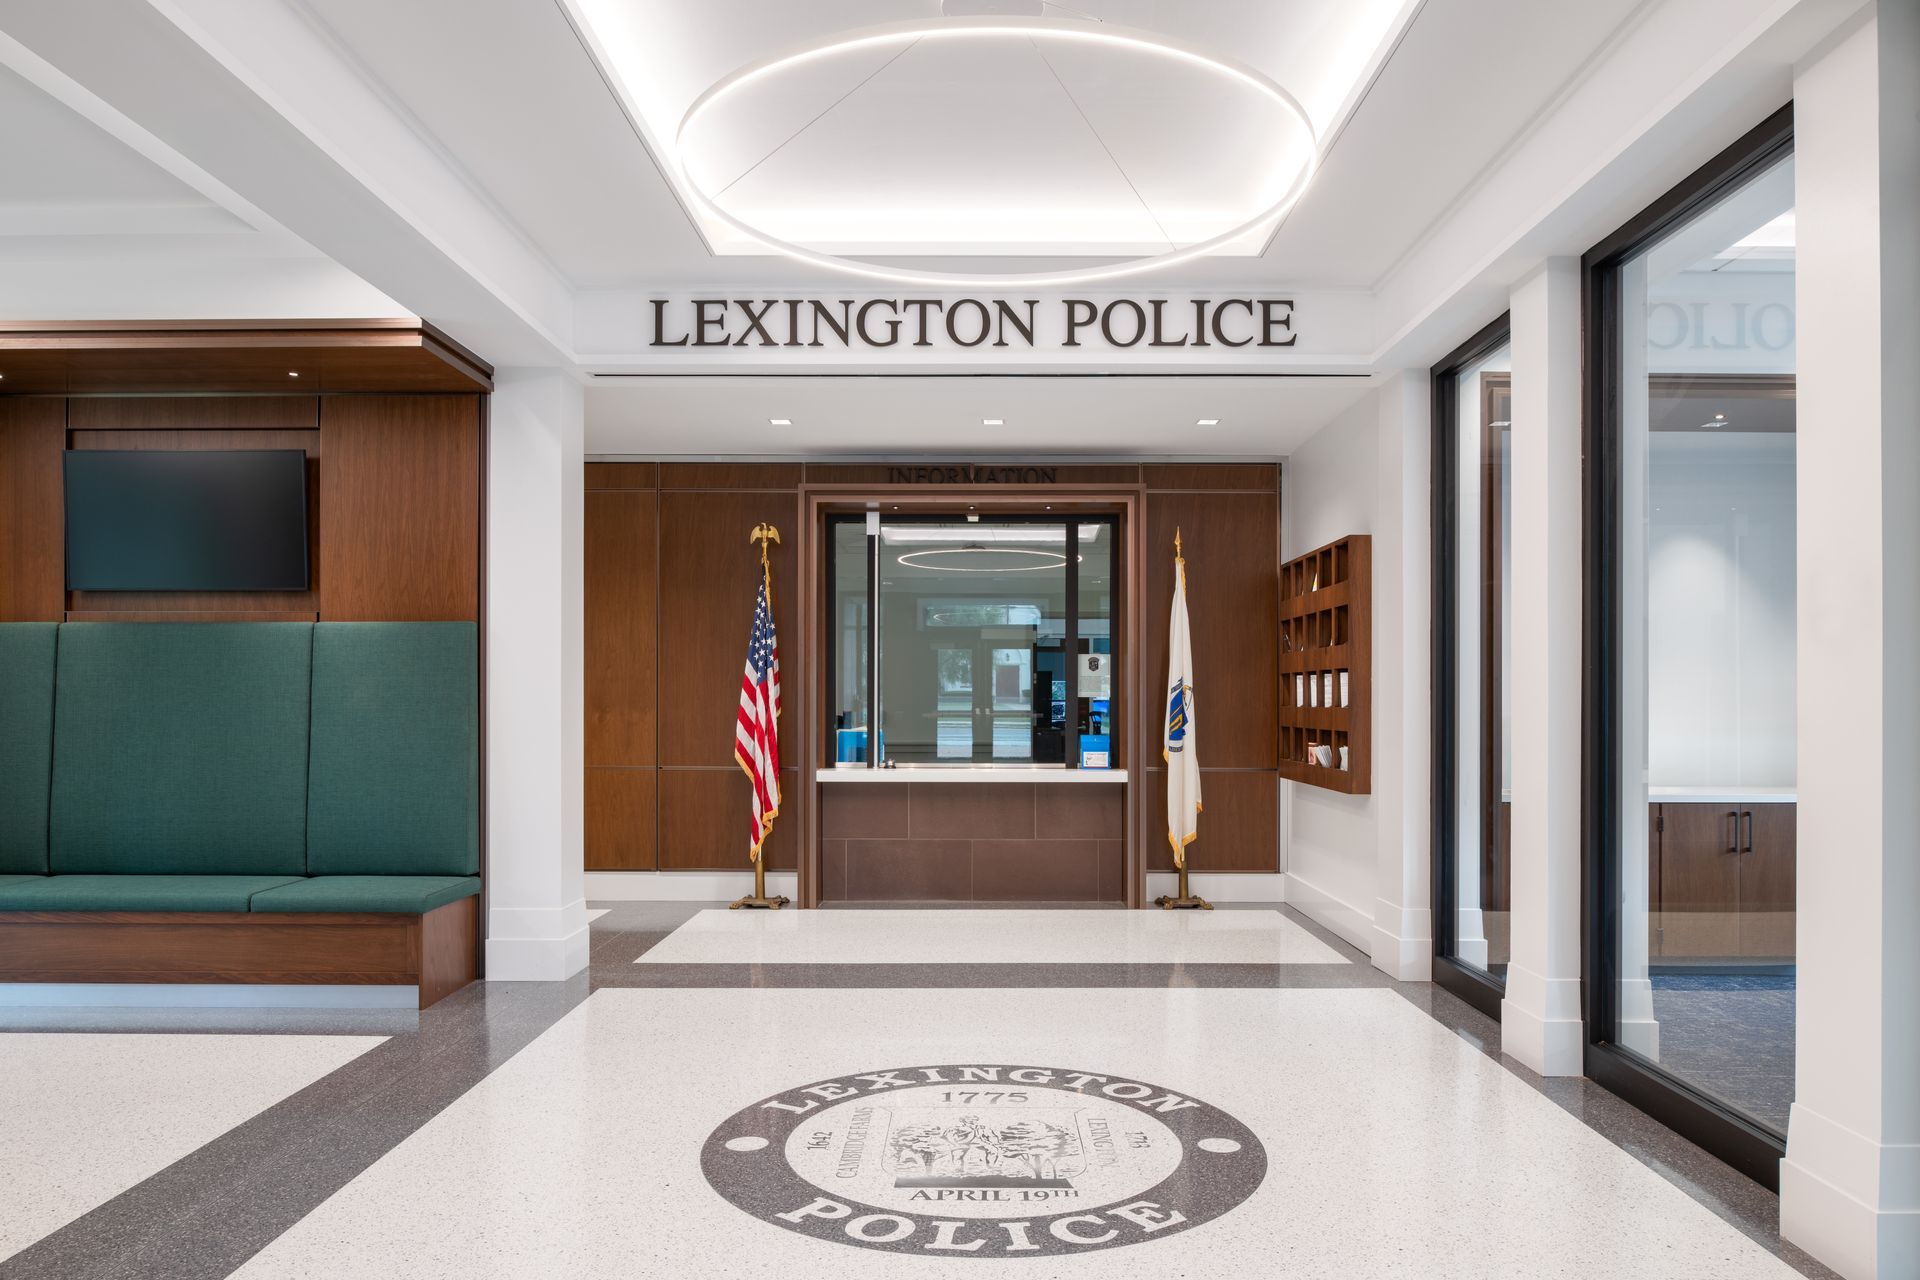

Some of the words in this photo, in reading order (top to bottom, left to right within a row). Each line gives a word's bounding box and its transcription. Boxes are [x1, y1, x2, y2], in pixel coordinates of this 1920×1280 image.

[649, 299, 1039, 347] LEXINGTON
[1061, 299, 1298, 347] POLICE
[888, 466, 1057, 484] INFORMATION
[761, 1066, 1200, 1114] LEXINGTON
[942, 1091, 1029, 1104] 1775
[806, 1131, 833, 1150] 1642
[910, 1189, 1011, 1201] APRIL
[1018, 1190, 1079, 1201] 19TH
[775, 1197, 1187, 1252] POLICE
